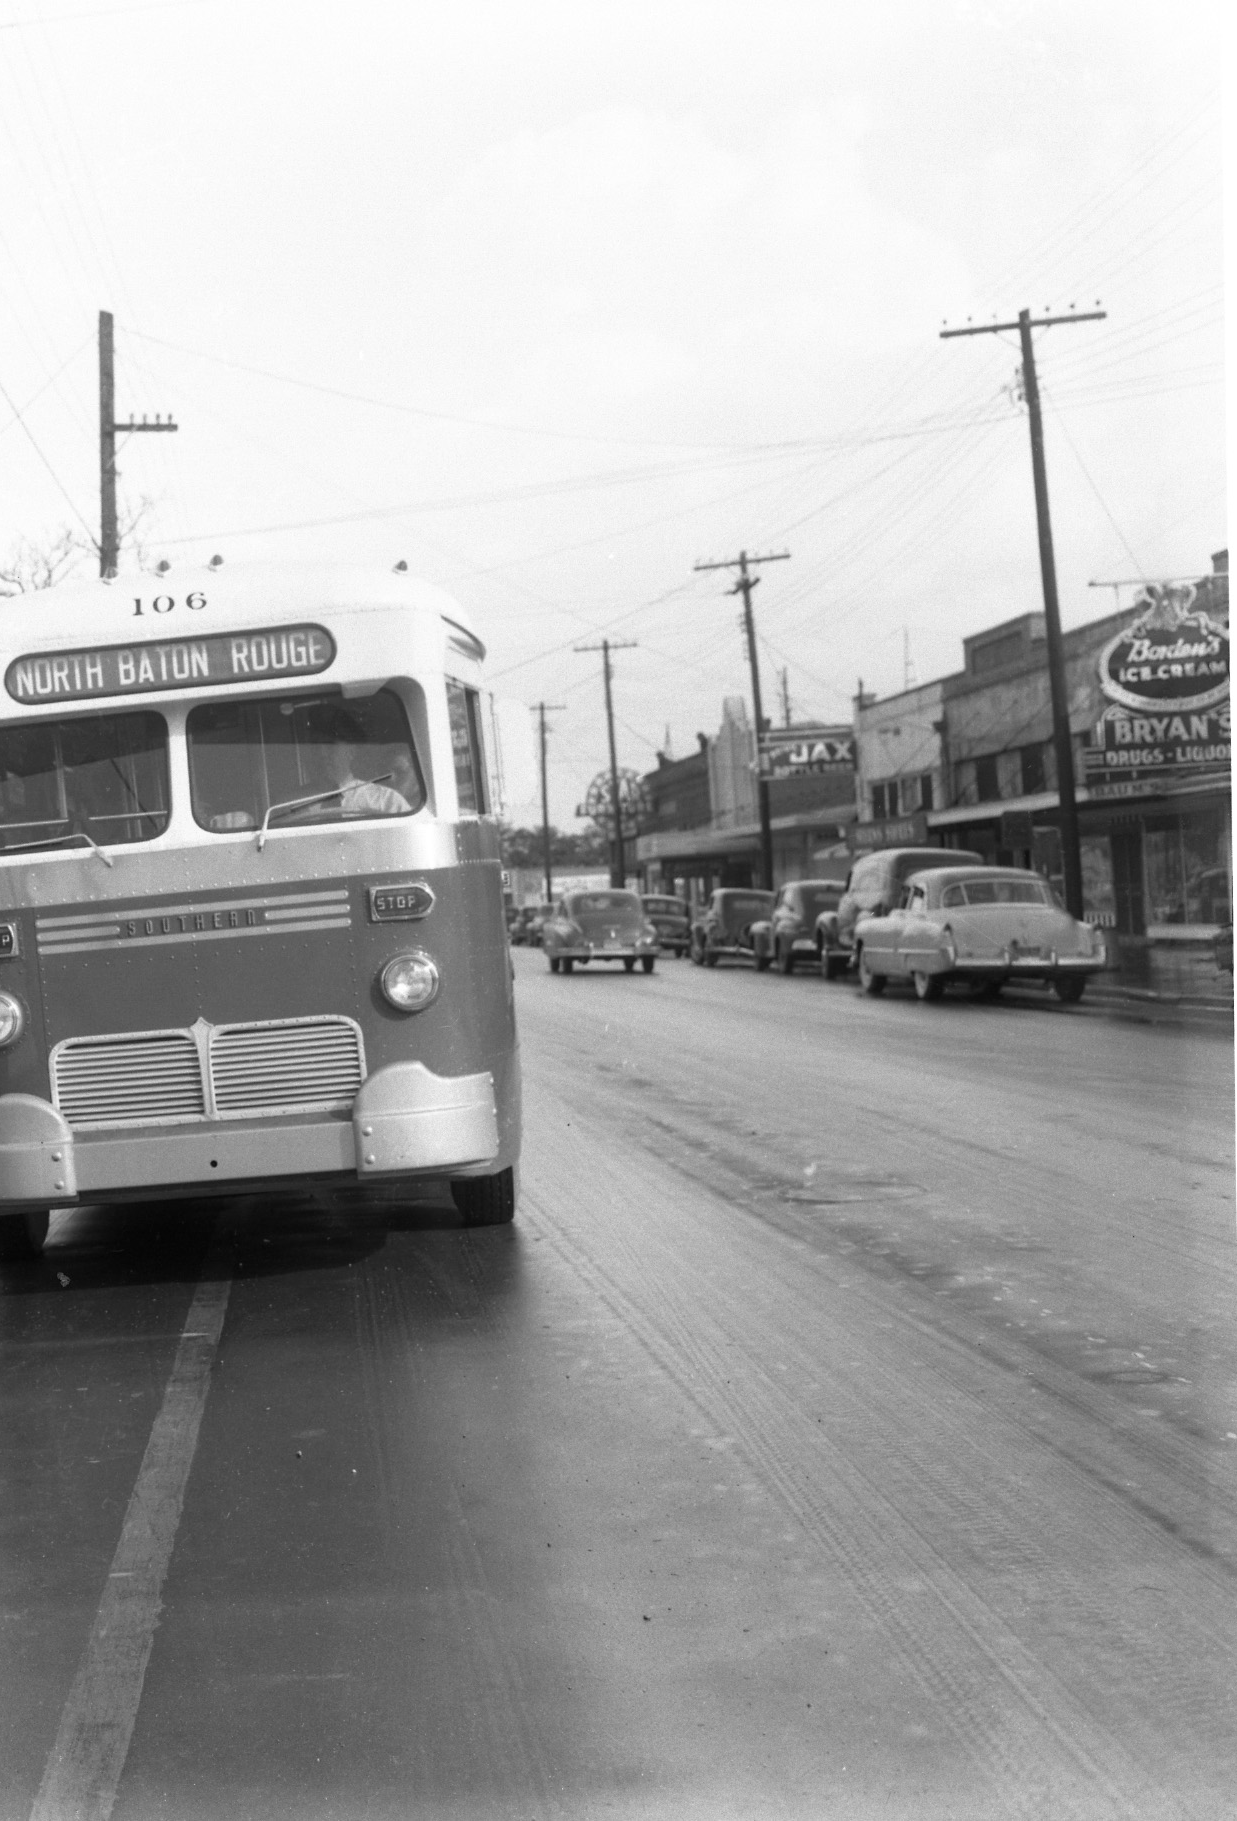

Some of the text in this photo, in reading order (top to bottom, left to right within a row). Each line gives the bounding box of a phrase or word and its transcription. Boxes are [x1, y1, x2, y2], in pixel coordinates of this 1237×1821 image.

[132, 592, 208, 616] 106
[1127, 635, 1221, 662] Borden's
[15, 632, 325, 697] NORTH BATON ROUGE
[1118, 661, 1227, 683] ICE CREAM
[1114, 712, 1230, 745] BRYAN'S
[789, 742, 853, 763] JAX
[1105, 749, 1164, 766] DRUGS
[376, 895, 416, 910] STOP
[128, 909, 256, 936] SOUTHERN
